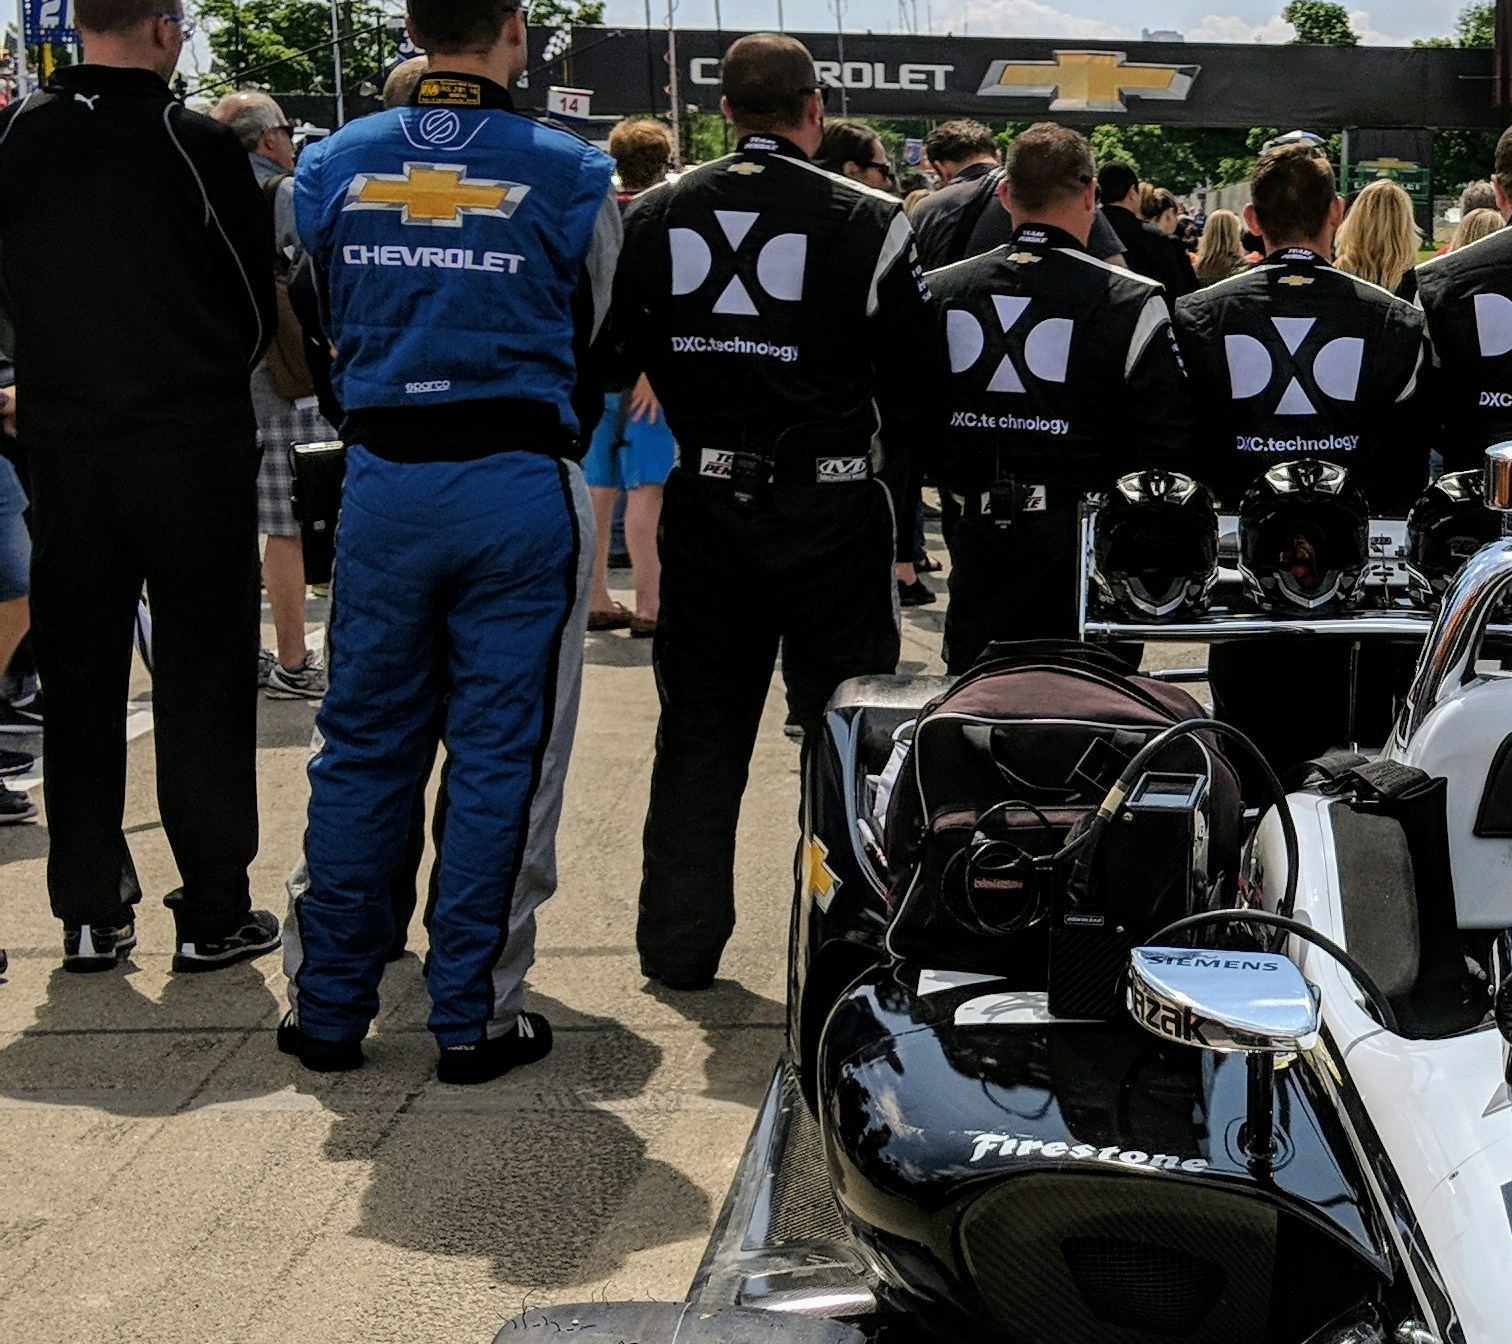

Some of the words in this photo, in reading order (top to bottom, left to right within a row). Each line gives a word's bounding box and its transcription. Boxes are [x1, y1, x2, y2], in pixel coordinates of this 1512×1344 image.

[690, 57, 954, 90] CROLET
[559, 97, 578, 113] 14
[343, 245, 526, 274] CHEVROLET
[671, 336, 799, 362] DXC.technology
[406, 380, 450, 393] sparco
[1236, 434, 1359, 453] DXC.technology
[1148, 956, 1278, 972] SIEMENS
[970, 1133, 1209, 1173] Firestone
